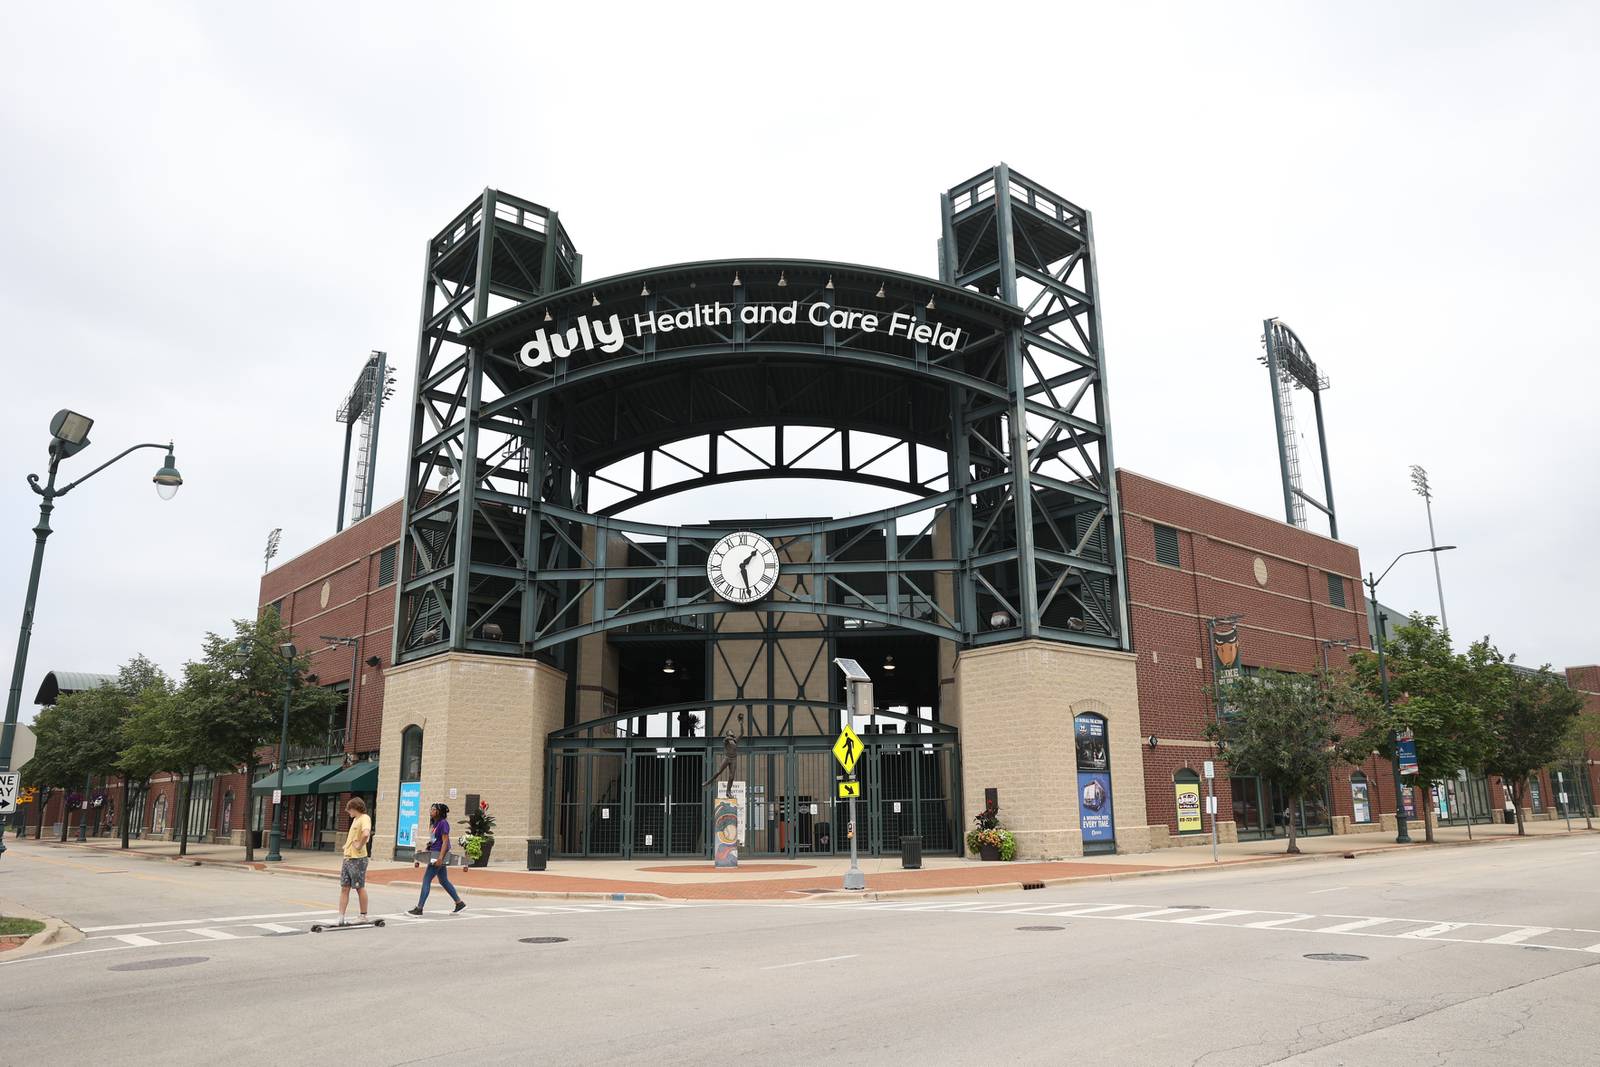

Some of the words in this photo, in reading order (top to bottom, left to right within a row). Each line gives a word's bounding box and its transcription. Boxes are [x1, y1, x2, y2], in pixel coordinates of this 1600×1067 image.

[520, 314, 624, 367] duly
[634, 302, 731, 337] Health
[740, 300, 798, 325] and
[808, 302, 878, 333] Care
[888, 312, 961, 351] Field
[0, 775, 15, 786] NE
[0, 787, 14, 797] AY
[1083, 820, 1097, 828] EVERY
